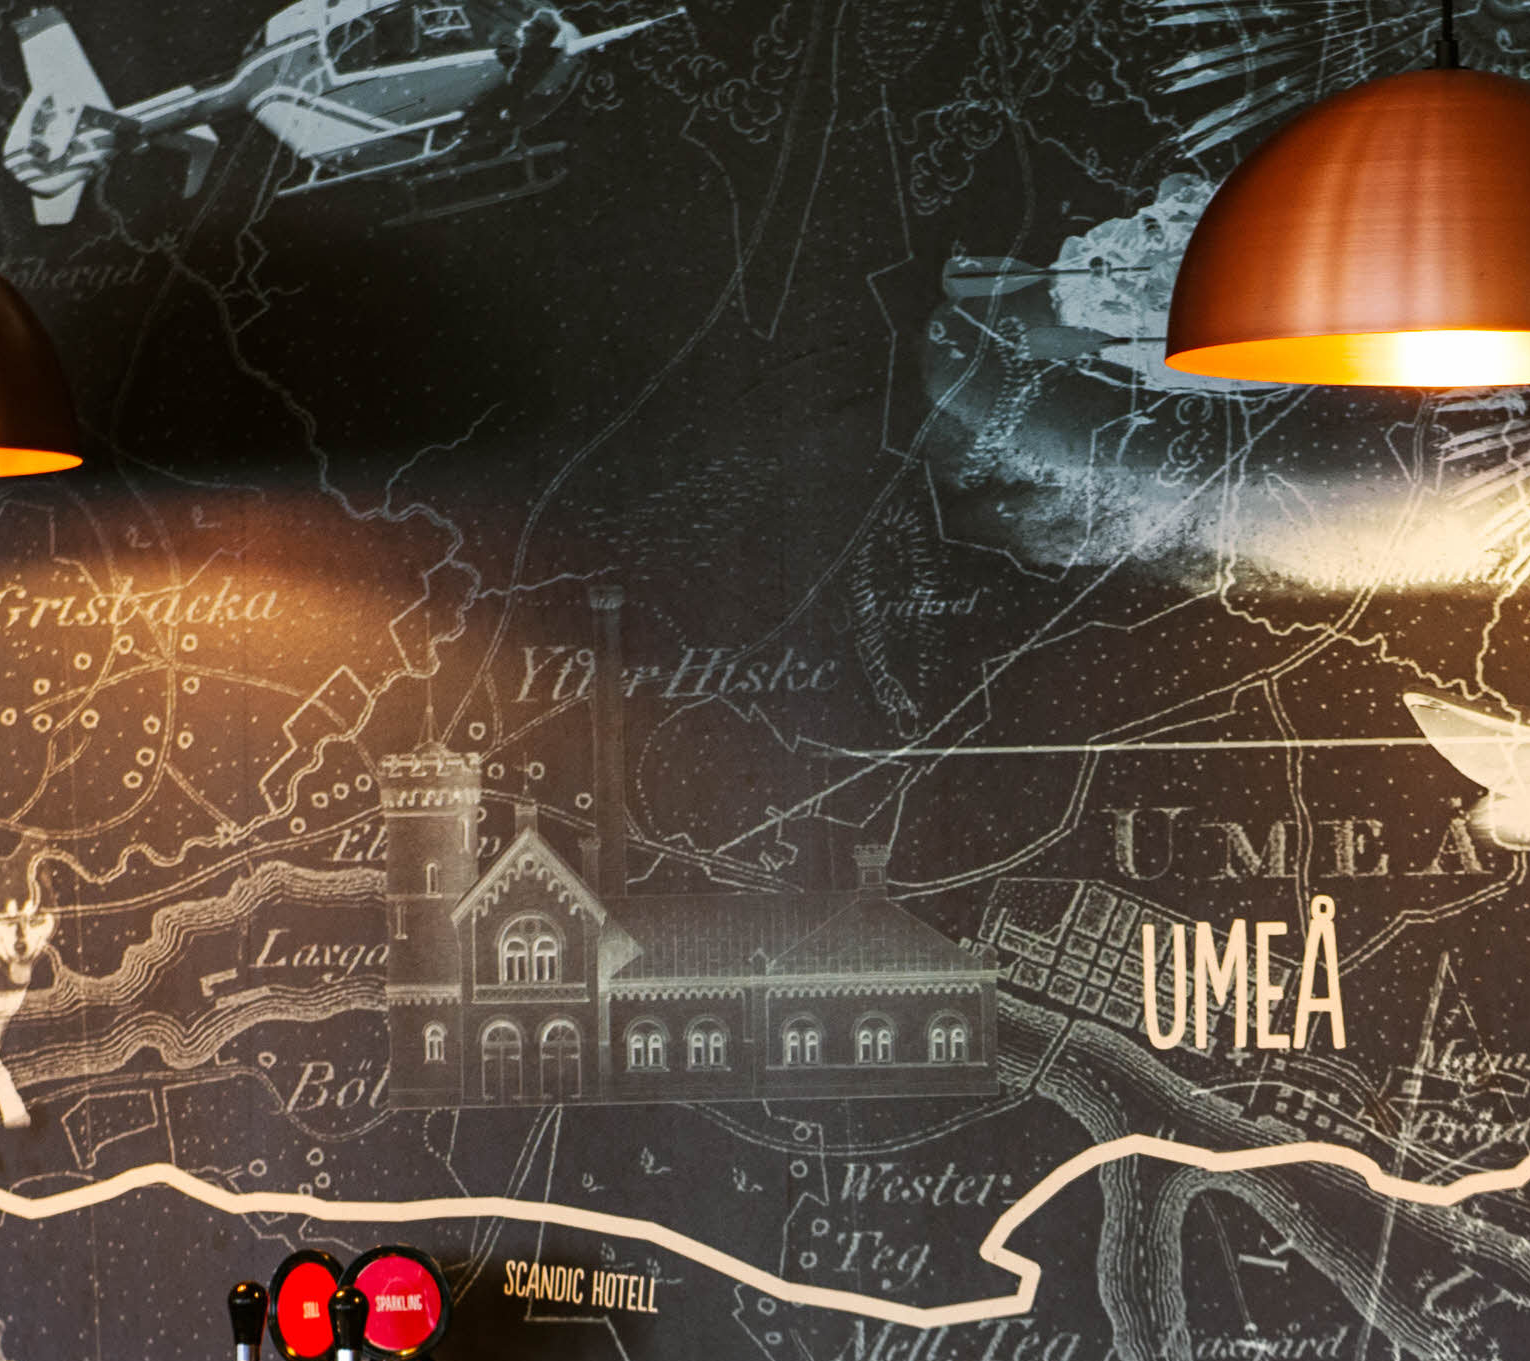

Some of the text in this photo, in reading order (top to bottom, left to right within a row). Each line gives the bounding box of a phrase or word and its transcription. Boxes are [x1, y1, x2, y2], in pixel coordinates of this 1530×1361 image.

[1141, 893, 1347, 1051] UMEÅ
[374, 1293, 423, 1313] SPARKLING
[503, 1259, 660, 1315] SCANDIC HOTELL
